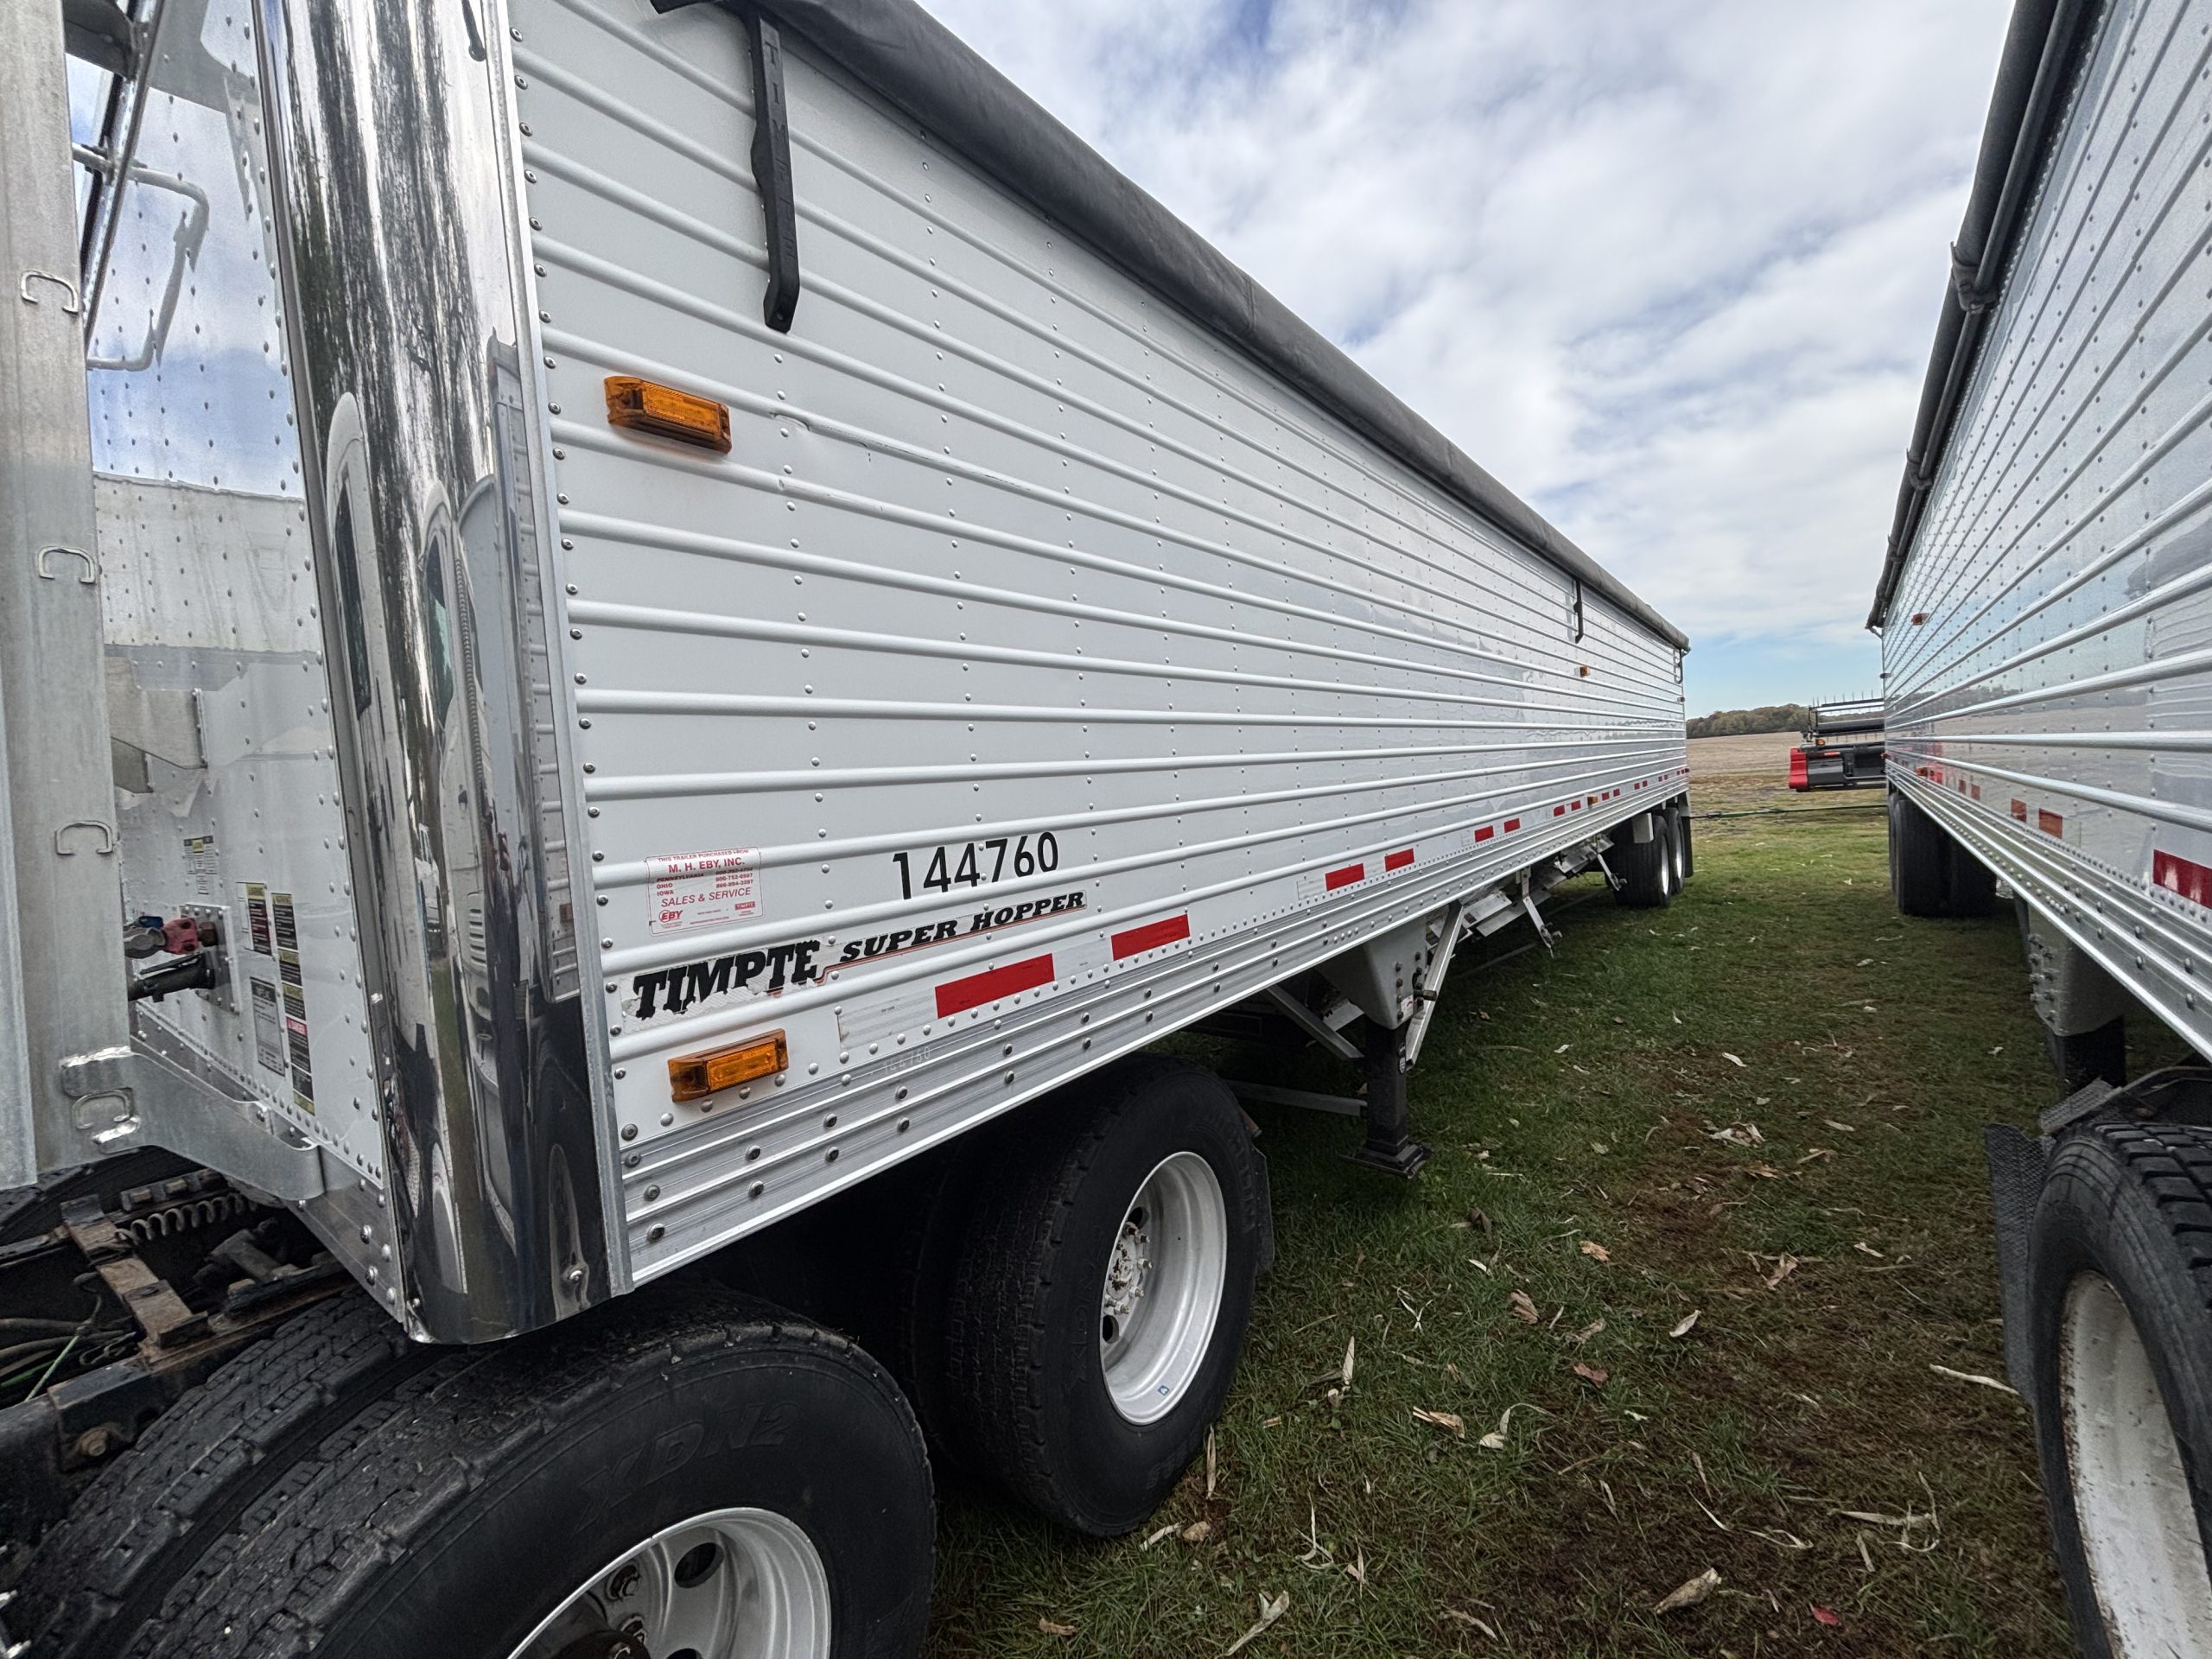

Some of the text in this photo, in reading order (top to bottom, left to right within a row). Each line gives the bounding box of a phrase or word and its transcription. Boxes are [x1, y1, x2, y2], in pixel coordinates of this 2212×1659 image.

[698, 850, 732, 859] PURCHASED
[668, 857, 746, 874] M. H. EBY, INC.
[892, 831, 1058, 900] 144760
[657, 872, 704, 883] PENNSYLVANIA
[661, 887, 752, 907] SALES & SERVICE
[660, 909, 683, 921] EBY
[632, 891, 1084, 1020] TIMPTE SUPER HOPPER
